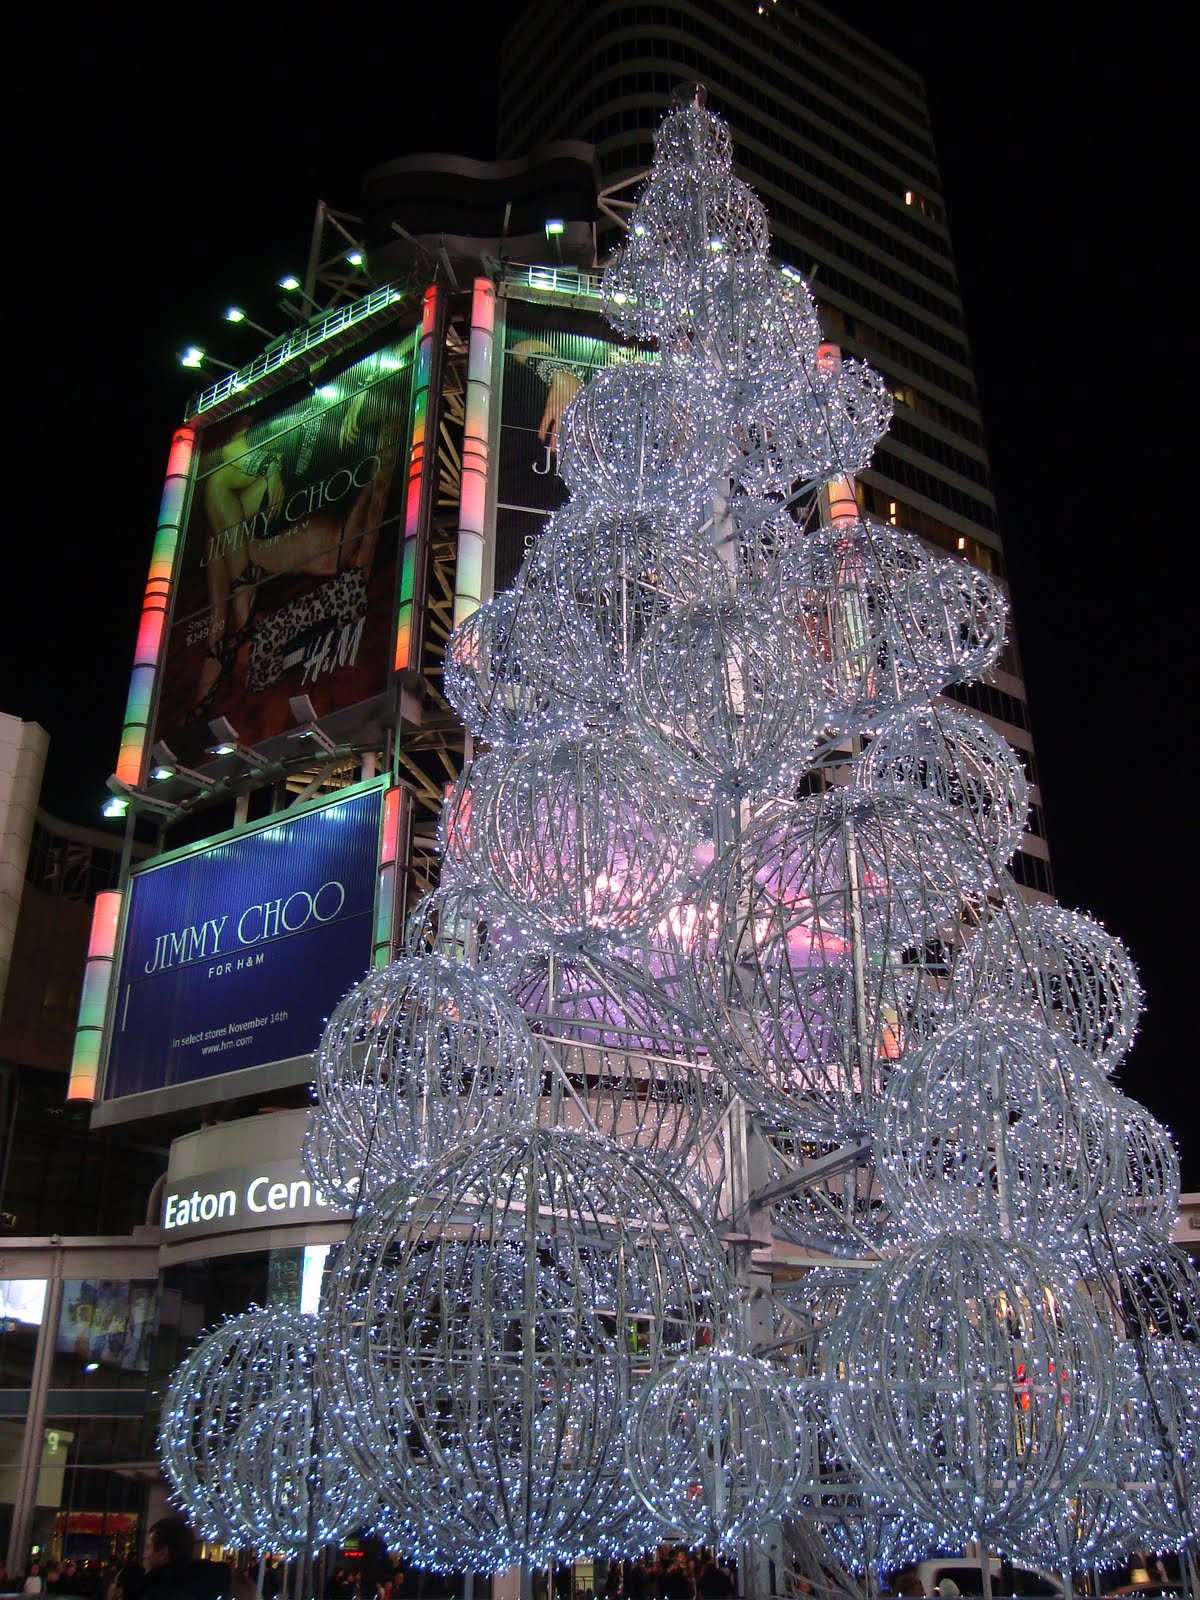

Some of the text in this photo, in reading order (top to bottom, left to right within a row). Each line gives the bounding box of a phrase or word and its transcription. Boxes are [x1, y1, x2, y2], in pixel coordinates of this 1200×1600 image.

[200, 455, 381, 567] JIMMY CHOO
[301, 615, 366, 686] H&M
[144, 881, 345, 974] JIMMY CHOO
[208, 952, 265, 978] FOR H&M
[181, 1031, 203, 1046] select
[204, 1026, 227, 1041] stores
[228, 1015, 269, 1034] November
[270, 1010, 288, 1024] 14th
[201, 1036, 253, 1055] www.hm.com
[164, 1190, 237, 1230] Eaton
